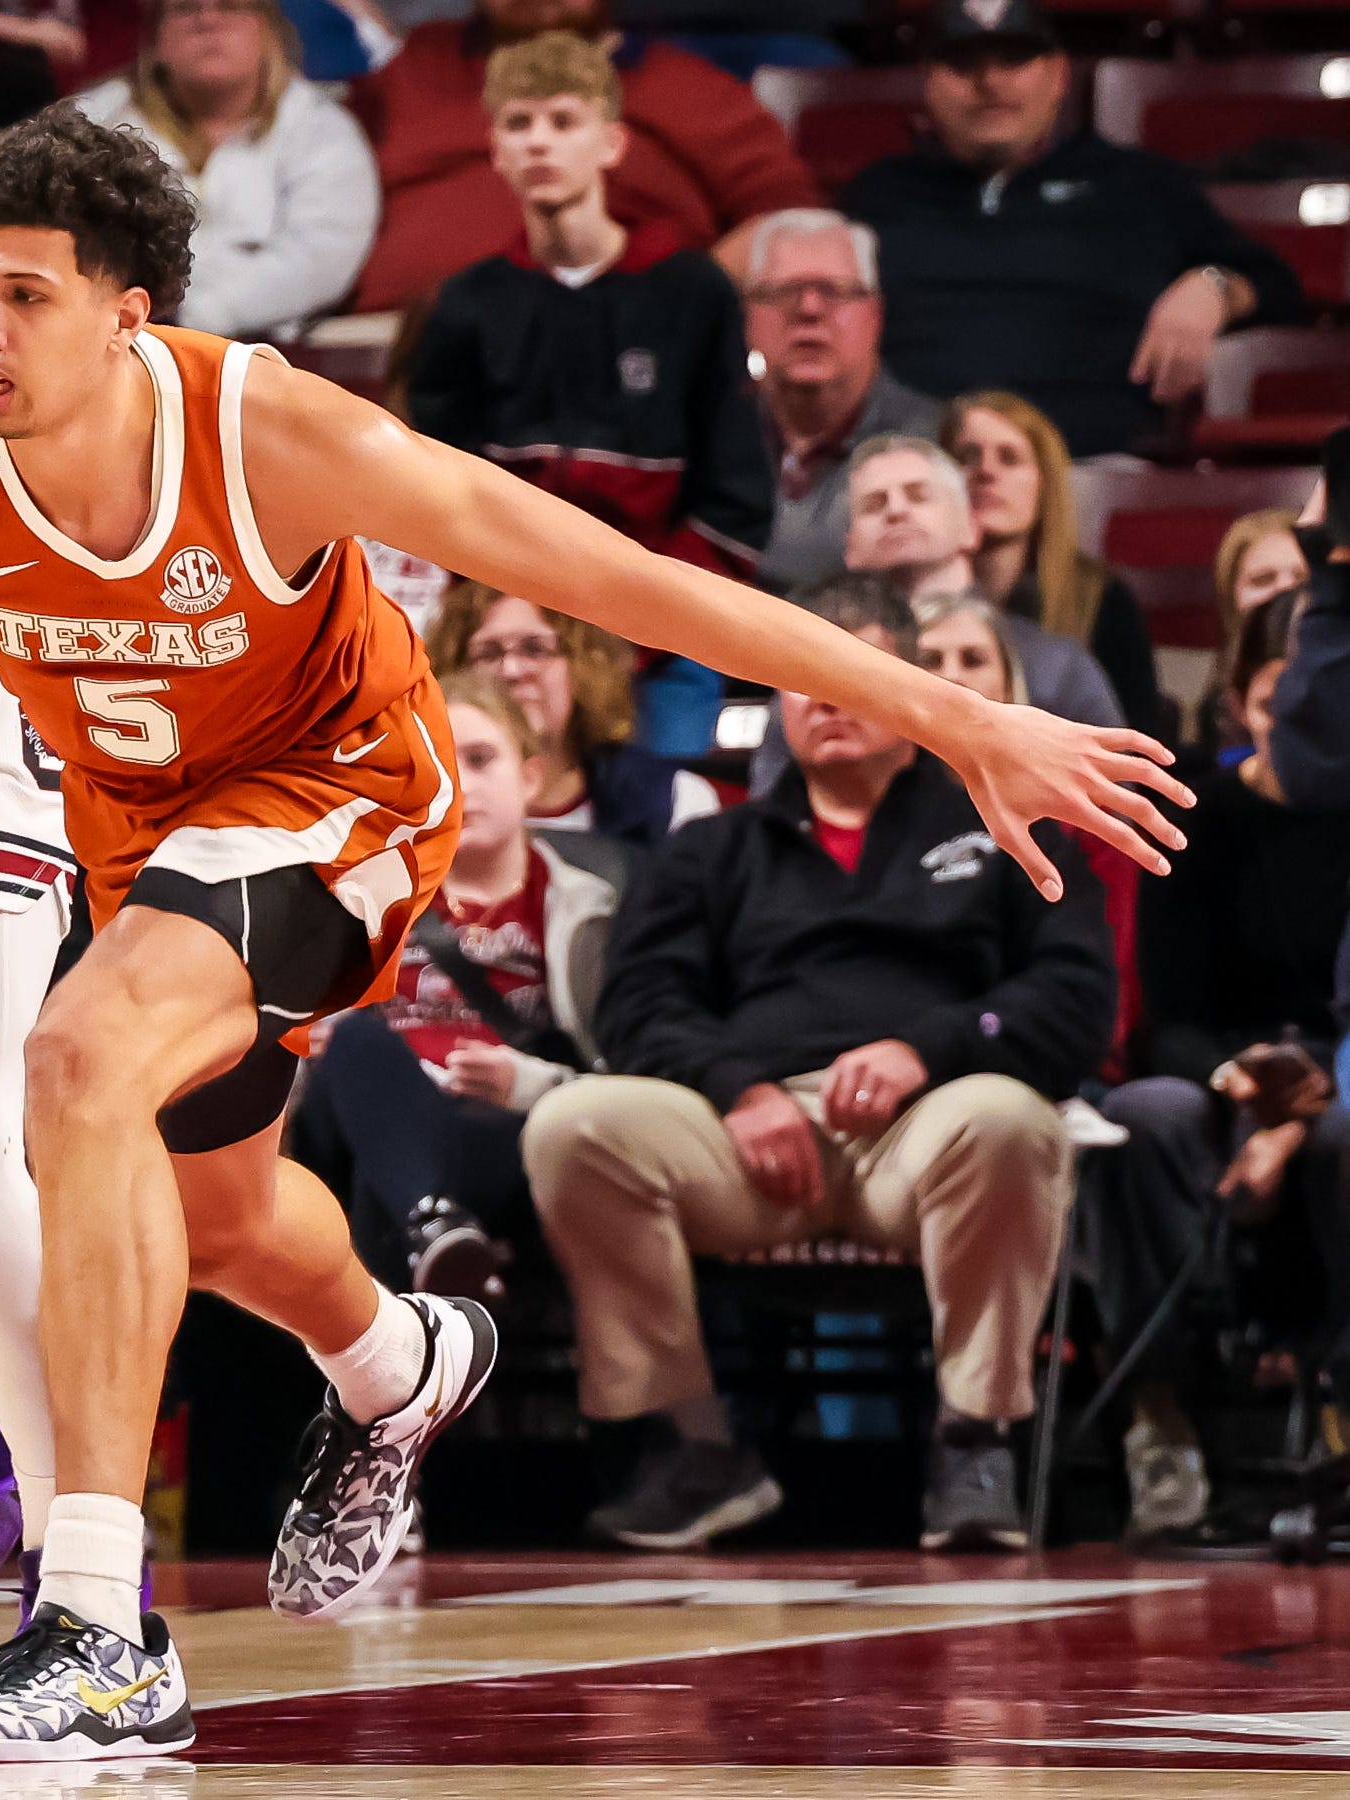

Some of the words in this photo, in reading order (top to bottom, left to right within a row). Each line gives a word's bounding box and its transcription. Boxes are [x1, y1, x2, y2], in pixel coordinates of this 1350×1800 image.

[168, 550, 218, 598] SEC
[169, 587, 227, 614] GRADUATE
[73, 676, 181, 766] 5
